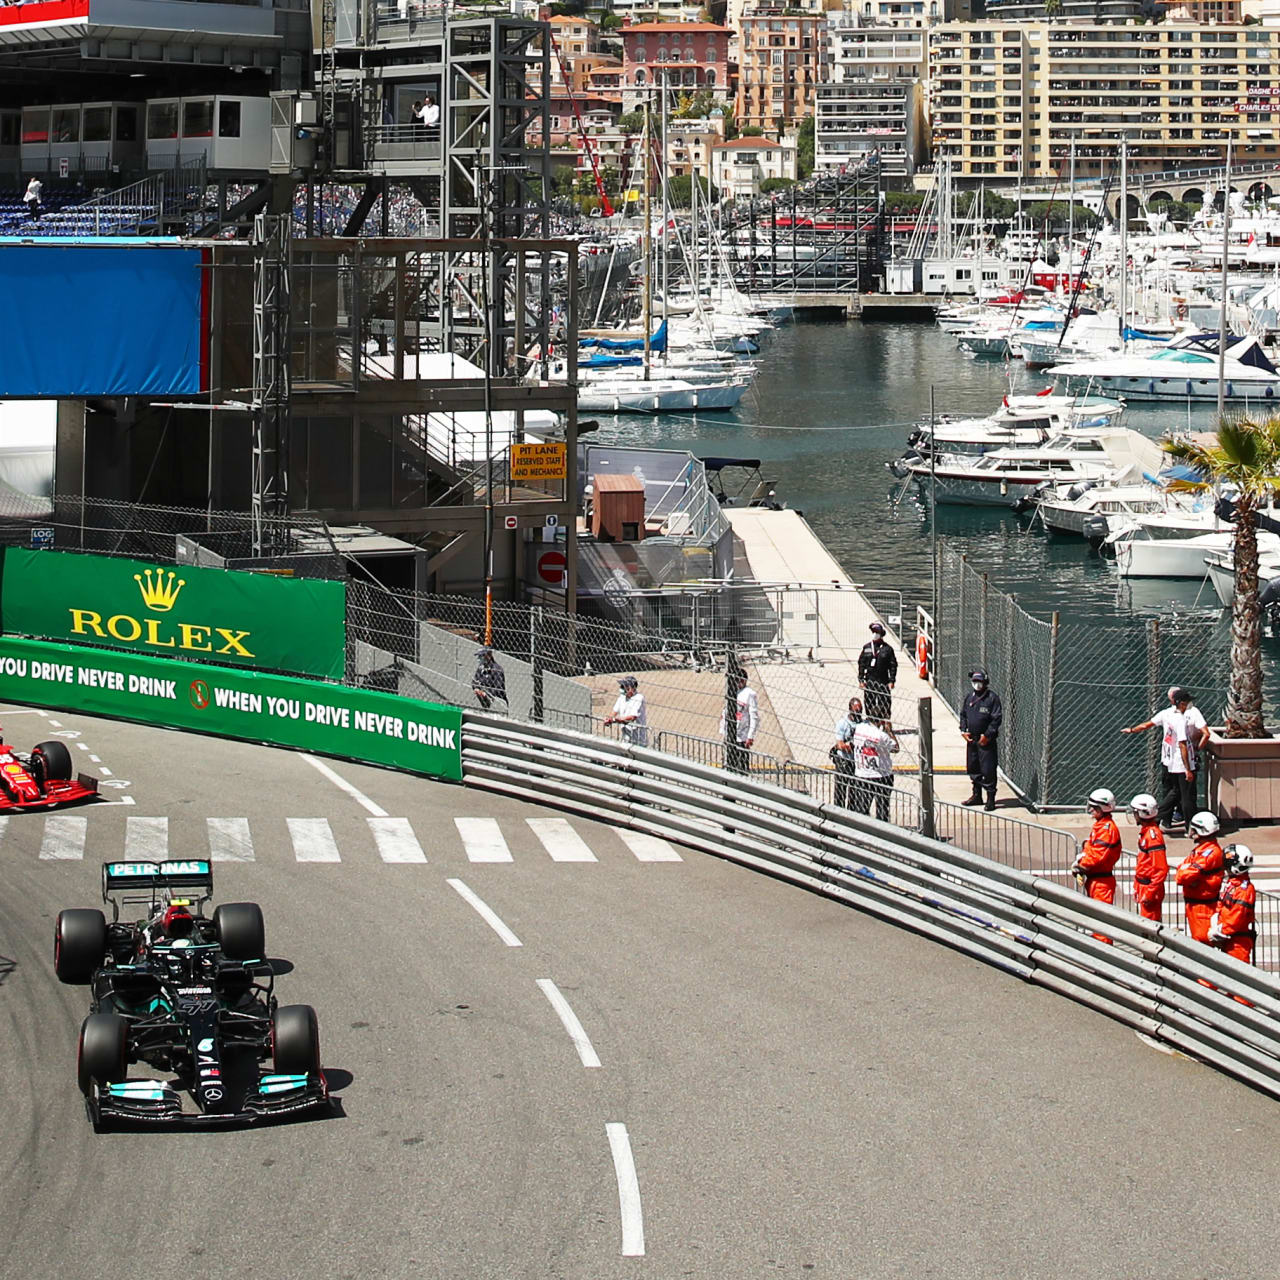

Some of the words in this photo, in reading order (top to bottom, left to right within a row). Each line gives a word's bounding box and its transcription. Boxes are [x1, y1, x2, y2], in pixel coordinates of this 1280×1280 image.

[516, 458, 544, 466] RESERVED
[545, 457, 561, 465] STAFF
[520, 446, 533, 454] PIT
[535, 446, 558, 454] LANE
[515, 468, 528, 476] AND
[530, 468, 563, 476] MECHANICS
[68, 608, 256, 658] ROLEX
[31, 660, 74, 683] DRIVE
[77, 667, 125, 691] NEVER
[128, 675, 177, 700] DRINK
[214, 687, 262, 714] WHEN
[266, 696, 301, 719] YOU
[304, 702, 350, 728] DRIVE
[354, 710, 404, 739] NEVER
[407, 721, 457, 750] DRINK
